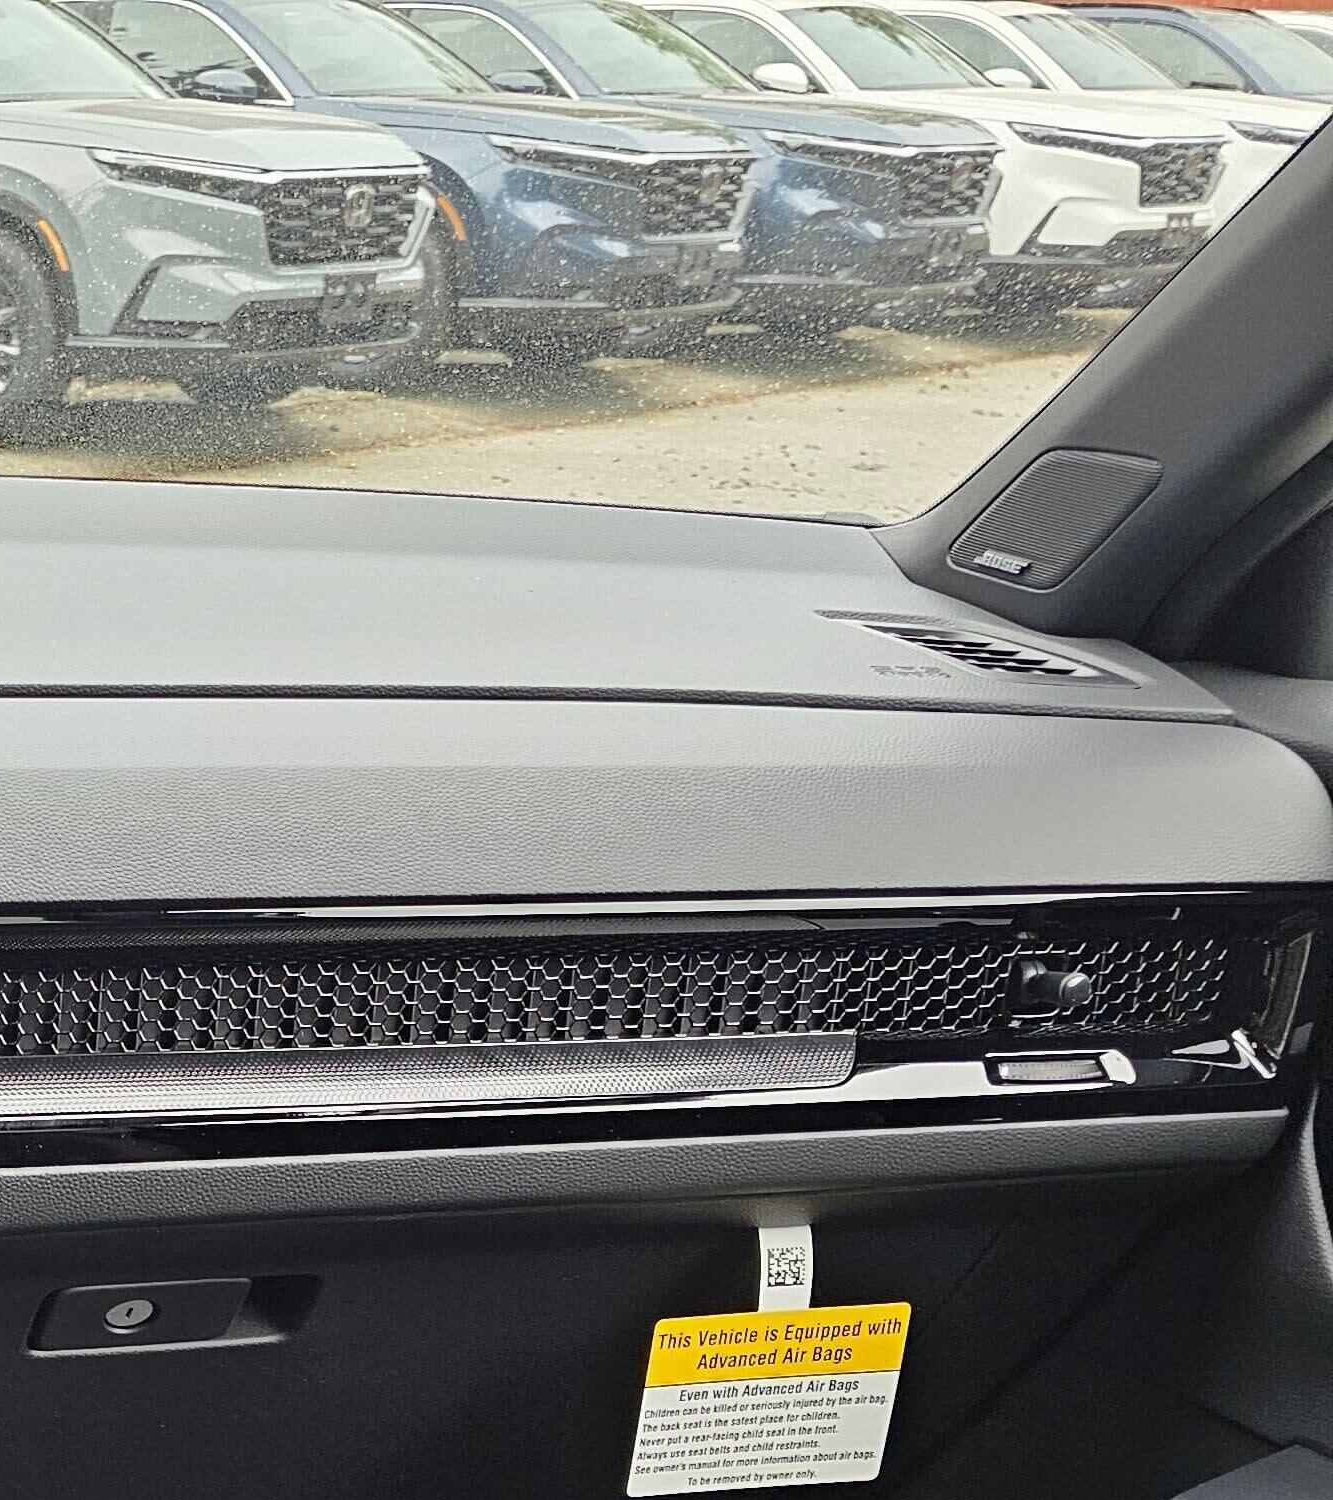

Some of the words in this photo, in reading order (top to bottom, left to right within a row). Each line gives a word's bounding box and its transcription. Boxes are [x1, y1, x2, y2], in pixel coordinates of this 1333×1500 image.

[659, 1332, 692, 1349] This
[699, 1328, 758, 1346] Vehicle
[764, 1325, 778, 1341] is
[785, 1321, 863, 1343] Equipped
[868, 1318, 902, 1335] with
[697, 1349, 777, 1370] Advanced
[782, 1347, 807, 1364] Air
[812, 1346, 853, 1364] Bags
[679, 1389, 708, 1402] Even
[713, 1386, 739, 1399] with
[742, 1381, 802, 1397] Advanced
[806, 1380, 825, 1393] Air
[829, 1379, 860, 1393] Bags
[645, 1407, 680, 1419] Children
[683, 1407, 698, 1416] can
[701, 1405, 711, 1414] be
[714, 1402, 737, 1413] killed
[740, 1403, 749, 1411] or
[751, 1399, 790, 1411] seriously
[793, 1397, 824, 1409] injured
[826, 1396, 836, 1407] by
[839, 1395, 853, 1405] the
[855, 1394, 868, 1404] air
[869, 1394, 888, 1405] bag.
[643, 1424, 658, 1433] The
[661, 1422, 680, 1431] back
[683, 1421, 702, 1430] seat
[704, 1420, 712, 1428] is
[715, 1418, 729, 1427] the
[731, 1415, 757, 1426] safest
[760, 1413, 784, 1425] place
[786, 1413, 799, 1422] for
[801, 1411, 841, 1421] children.
[640, 1437, 665, 1446] Never
[667, 1435, 681, 1445] put
[691, 1431, 740, 1442] rear-facing
[742, 1429, 763, 1439] child
[766, 1427, 785, 1437] seat
[787, 1427, 796, 1435] in
[798, 1426, 812, 1435] the
[815, 1424, 838, 1434] front.
[637, 1451, 668, 1461] Always
[671, 1450, 685, 1458] use
[688, 1447, 707, 1456] seat
[709, 1445, 731, 1455] belts
[733, 1443, 749, 1453] and
[752, 1442, 773, 1452] child
[776, 1439, 821, 1450] restraints.
[635, 1465, 651, 1475] See
[653, 1462, 686, 1473] owner's
[689, 1460, 720, 1471] manual
[723, 1458, 734, 1468] for
[736, 1458, 758, 1467] more
[761, 1454, 810, 1465] information
[813, 1452, 837, 1462] about
[839, 1450, 851, 1460] air
[853, 1449, 877, 1460] bags.
[688, 1477, 697, 1486] To
[700, 1476, 710, 1485] be
[713, 1473, 751, 1484] removed
[754, 1472, 764, 1482] by
[766, 1471, 793, 1480] owner
[796, 1469, 817, 1480] only.
